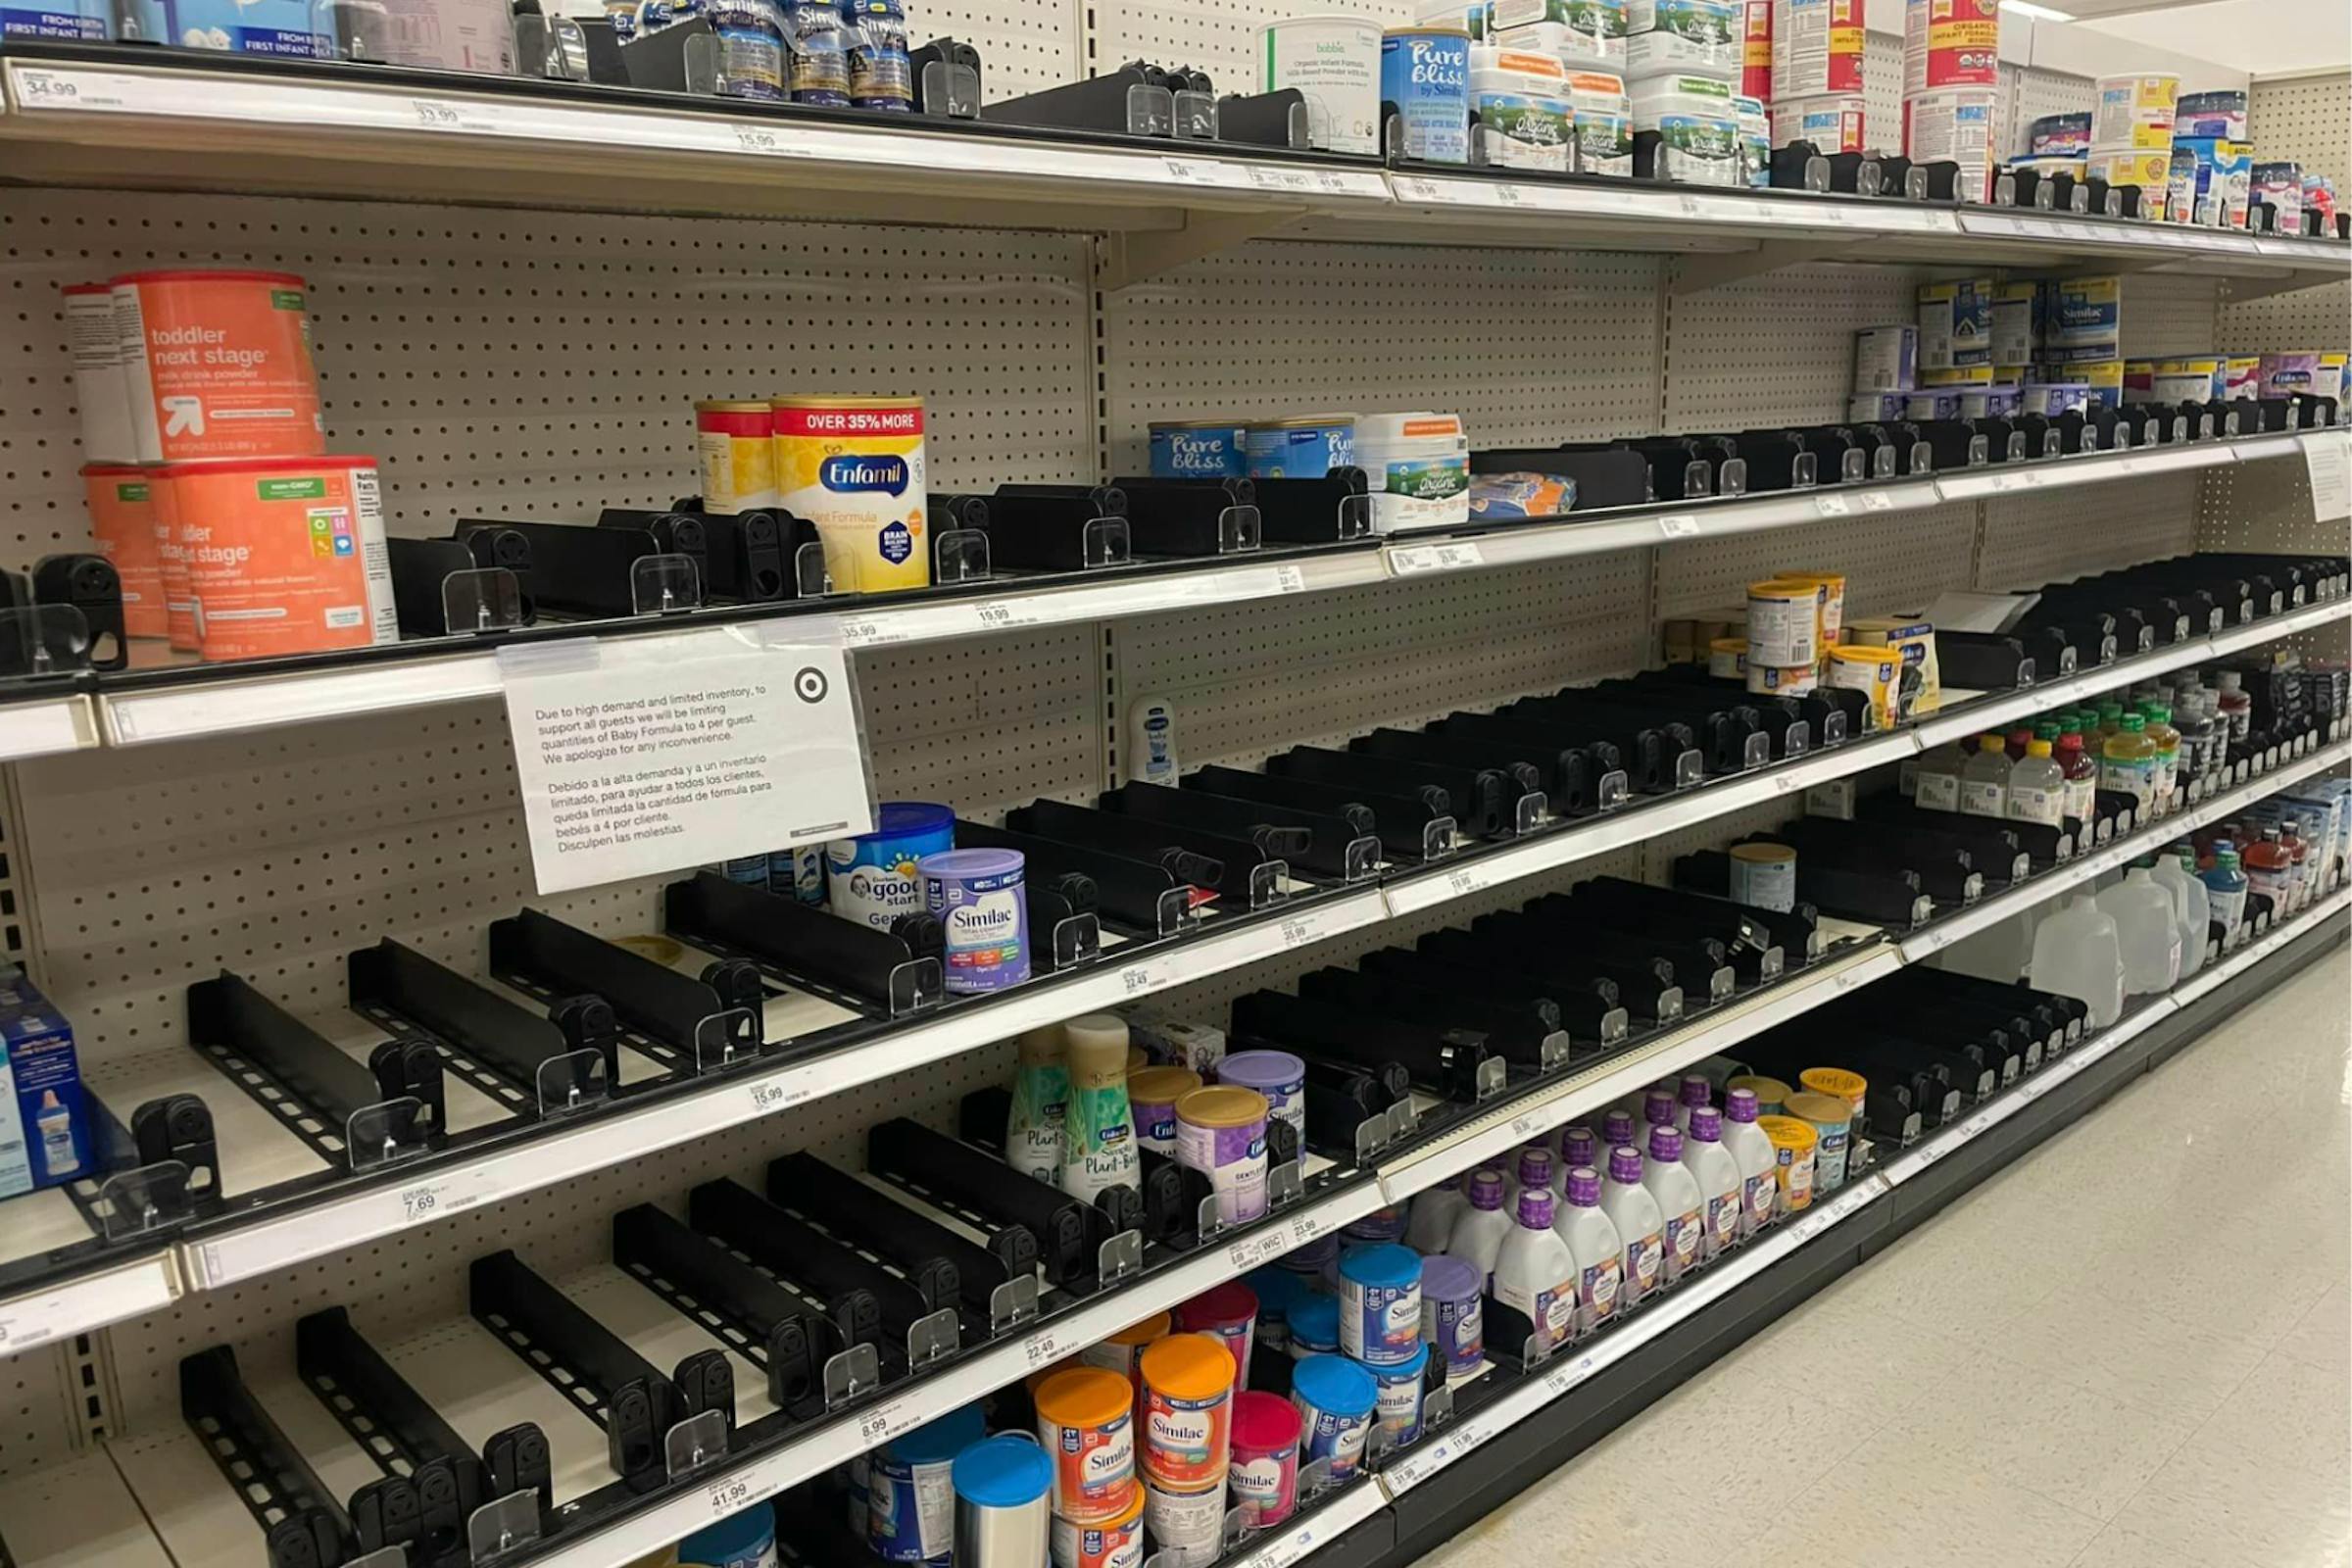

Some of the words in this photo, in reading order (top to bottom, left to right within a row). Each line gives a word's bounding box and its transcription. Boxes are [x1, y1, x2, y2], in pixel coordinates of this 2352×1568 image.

[41, 15, 75, 26] FROM
[5, 24, 36, 35] FIRST
[39, 25, 79, 39] INFANT
[277, 32, 307, 44] FROM
[245, 40, 273, 51] FIRST
[275, 43, 310, 55] INFANT
[1411, 44, 1465, 67] Pure
[1411, 64, 1464, 86] Bliss
[27, 81, 77, 96] 34.99
[1421, 86, 1434, 97] by
[737, 132, 776, 147] 15.99
[2062, 307, 2103, 318] Similac
[152, 327, 226, 345] toddler
[155, 347, 199, 366] next
[204, 346, 266, 368] stage
[214, 369, 259, 380] powder
[807, 415, 846, 429] OVER
[849, 415, 881, 429] 35%
[882, 414, 914, 428] MORE
[1171, 435, 1223, 453] Pure
[1171, 454, 1224, 468] Bliss
[830, 463, 901, 485] Enfamil
[831, 511, 877, 522] Formula
[884, 530, 907, 540] BRAIN
[198, 545, 249, 565] stage
[979, 609, 1009, 622] 19.99
[843, 624, 877, 638] 35.99
[535, 710, 559, 720] Due
[561, 709, 572, 717] to
[575, 705, 599, 716] high
[601, 699, 645, 712] demand
[648, 696, 667, 707] and
[669, 692, 704, 704] limited
[706, 687, 755, 700] inventory,
[755, 685, 765, 694] to
[538, 721, 582, 735] support
[584, 719, 596, 729] all
[599, 715, 635, 729] guests
[637, 713, 653, 722] we
[656, 710, 671, 719] will
[674, 709, 687, 718] be
[690, 705, 726, 715] limiting
[541, 735, 595, 751] quantities
[597, 732, 608, 743] of
[611, 729, 638, 741] Baby
[641, 723, 683, 736] Formula
[685, 722, 696, 731] to
[699, 719, 706, 729] 4
[708, 719, 723, 729] per
[726, 713, 757, 727] guest.
[543, 753, 563, 764] We
[564, 746, 617, 762] apologize
[619, 744, 634, 754] for
[637, 742, 656, 754] any
[659, 732, 733, 749] inconvenience.
[549, 781, 589, 794] Debido
[591, 779, 599, 788] a
[601, 776, 612, 787] la
[613, 773, 633, 785] alta
[636, 765, 684, 781] demanda
[686, 766, 693, 775] y
[705, 761, 717, 771] un
[719, 755, 766, 767] inventario
[551, 794, 600, 808] limitado,
[601, 790, 626, 803] para
[628, 784, 663, 798] ayudar
[675, 778, 704, 790] todos
[706, 775, 721, 785] los
[723, 769, 764, 782] clientes,
[554, 809, 589, 823] queda
[591, 803, 634, 817] limitada
[636, 801, 646, 810] la
[648, 793, 693, 808] cantidad
[695, 791, 708, 801] de
[750, 782, 772, 794] para
[593, 823, 601, 832] a
[604, 820, 611, 829] 4
[612, 818, 631, 830] por
[634, 812, 670, 825] cliente.
[558, 836, 613, 853] Disculpen
[614, 833, 631, 843] las
[633, 823, 685, 840] molestias.
[887, 895, 918, 906] start
[955, 909, 1011, 928] Similac
[754, 1087, 782, 1104] 15.99
[1028, 1130, 1063, 1146] Plant-
[404, 1195, 435, 1214] 7.69
[1261, 1237, 1281, 1250] WIC
[1027, 1341, 1054, 1359] 22.49
[862, 1418, 887, 1438] 8.99
[1153, 1417, 1204, 1439] Similac
[1229, 1472, 1275, 1488] Similac
[711, 1483, 747, 1507] 41.99
